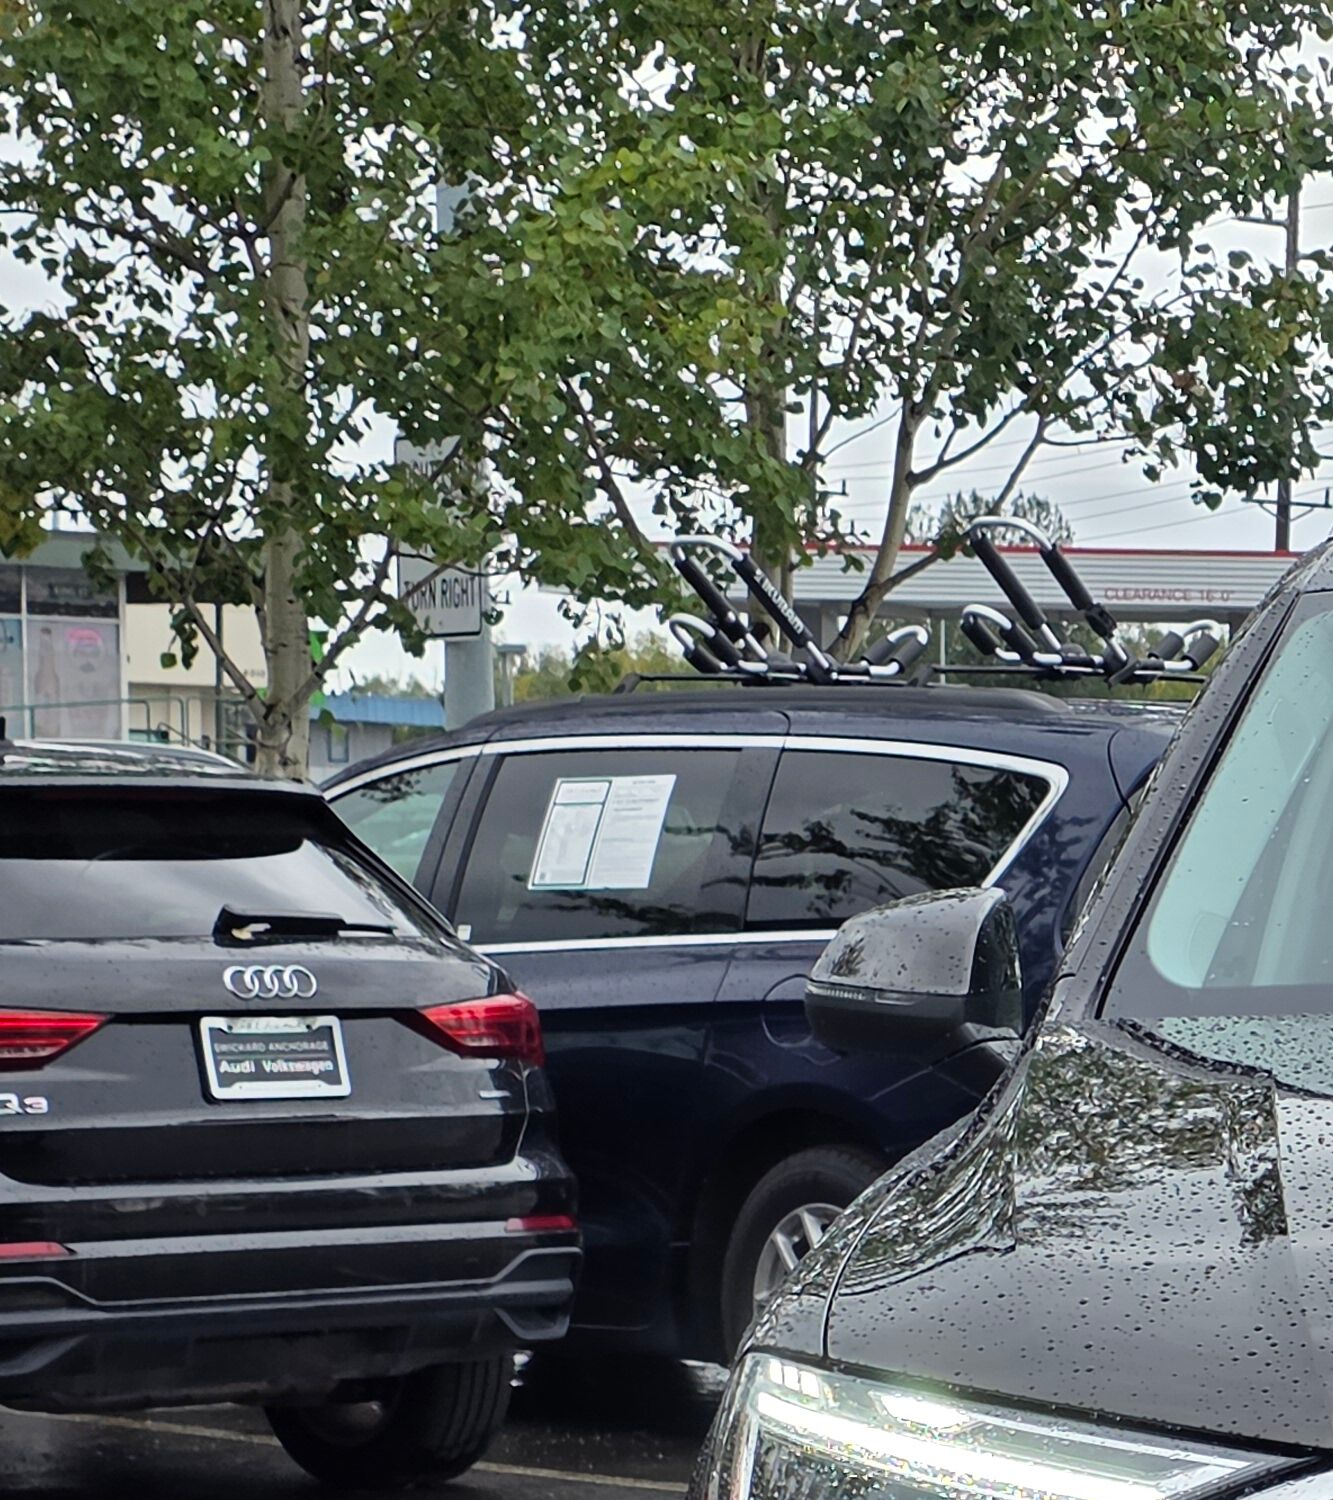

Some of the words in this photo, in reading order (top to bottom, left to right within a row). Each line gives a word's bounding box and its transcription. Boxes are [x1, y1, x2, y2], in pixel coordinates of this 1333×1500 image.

[440, 577, 476, 609] RIGHT
[1104, 587, 1192, 601] CLEARANCE
[219, 1060, 256, 1074] Audi
[261, 1059, 335, 1076] Volkswagen
